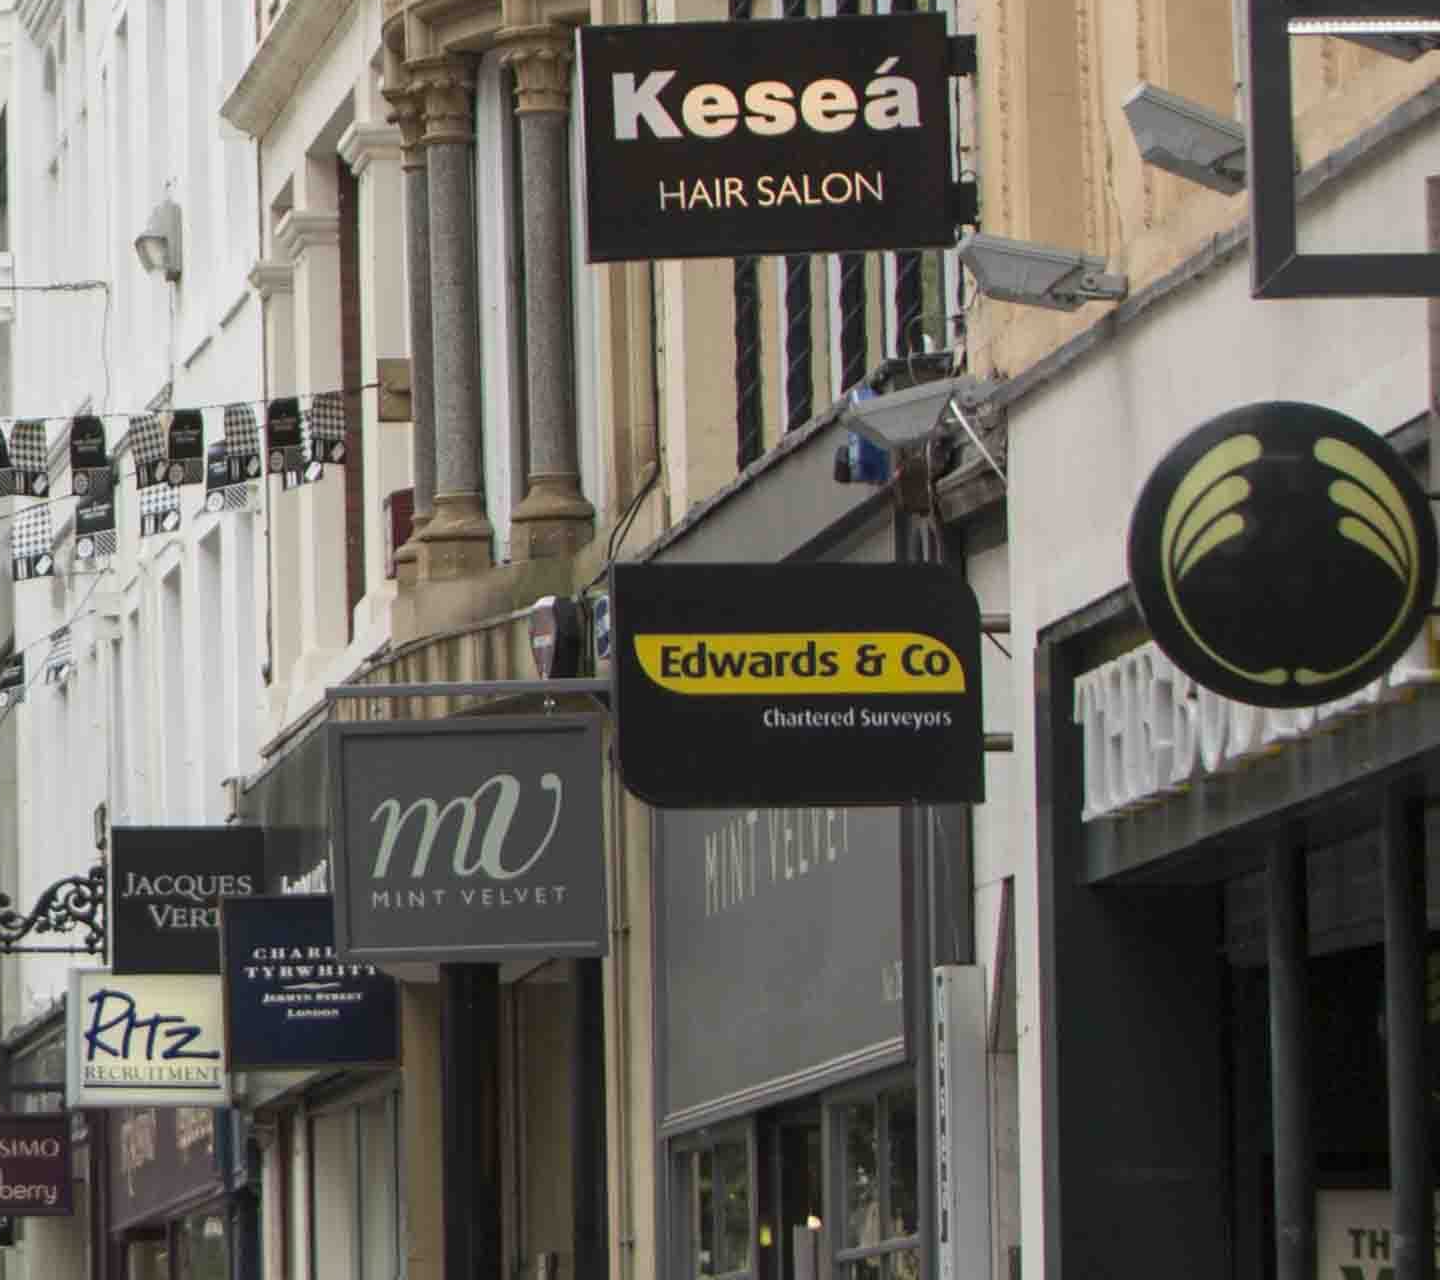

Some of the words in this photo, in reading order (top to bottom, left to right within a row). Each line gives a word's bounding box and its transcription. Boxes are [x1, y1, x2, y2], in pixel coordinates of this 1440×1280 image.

[611, 56, 921, 141] Keseá
[660, 176, 747, 211] HAIR
[757, 171, 883, 208] SALON
[660, 641, 839, 679] Edwards
[855, 645, 886, 675] &
[902, 643, 951, 676] Co
[763, 708, 855, 729] Chartered
[861, 707, 953, 732] Surveyors
[370, 773, 562, 879] mv
[705, 810, 759, 917] MINT
[122, 872, 252, 902] JACQUES
[372, 889, 448, 908] MINT
[460, 885, 567, 906] VELVET
[253, 946, 336, 960] CHARL
[243, 964, 376, 978] TYRWHITT
[287, 1008, 340, 1019] LONDON
[84, 1066, 220, 1081] RECRUITMENT
[1346, 1228, 1392, 1260] TH
